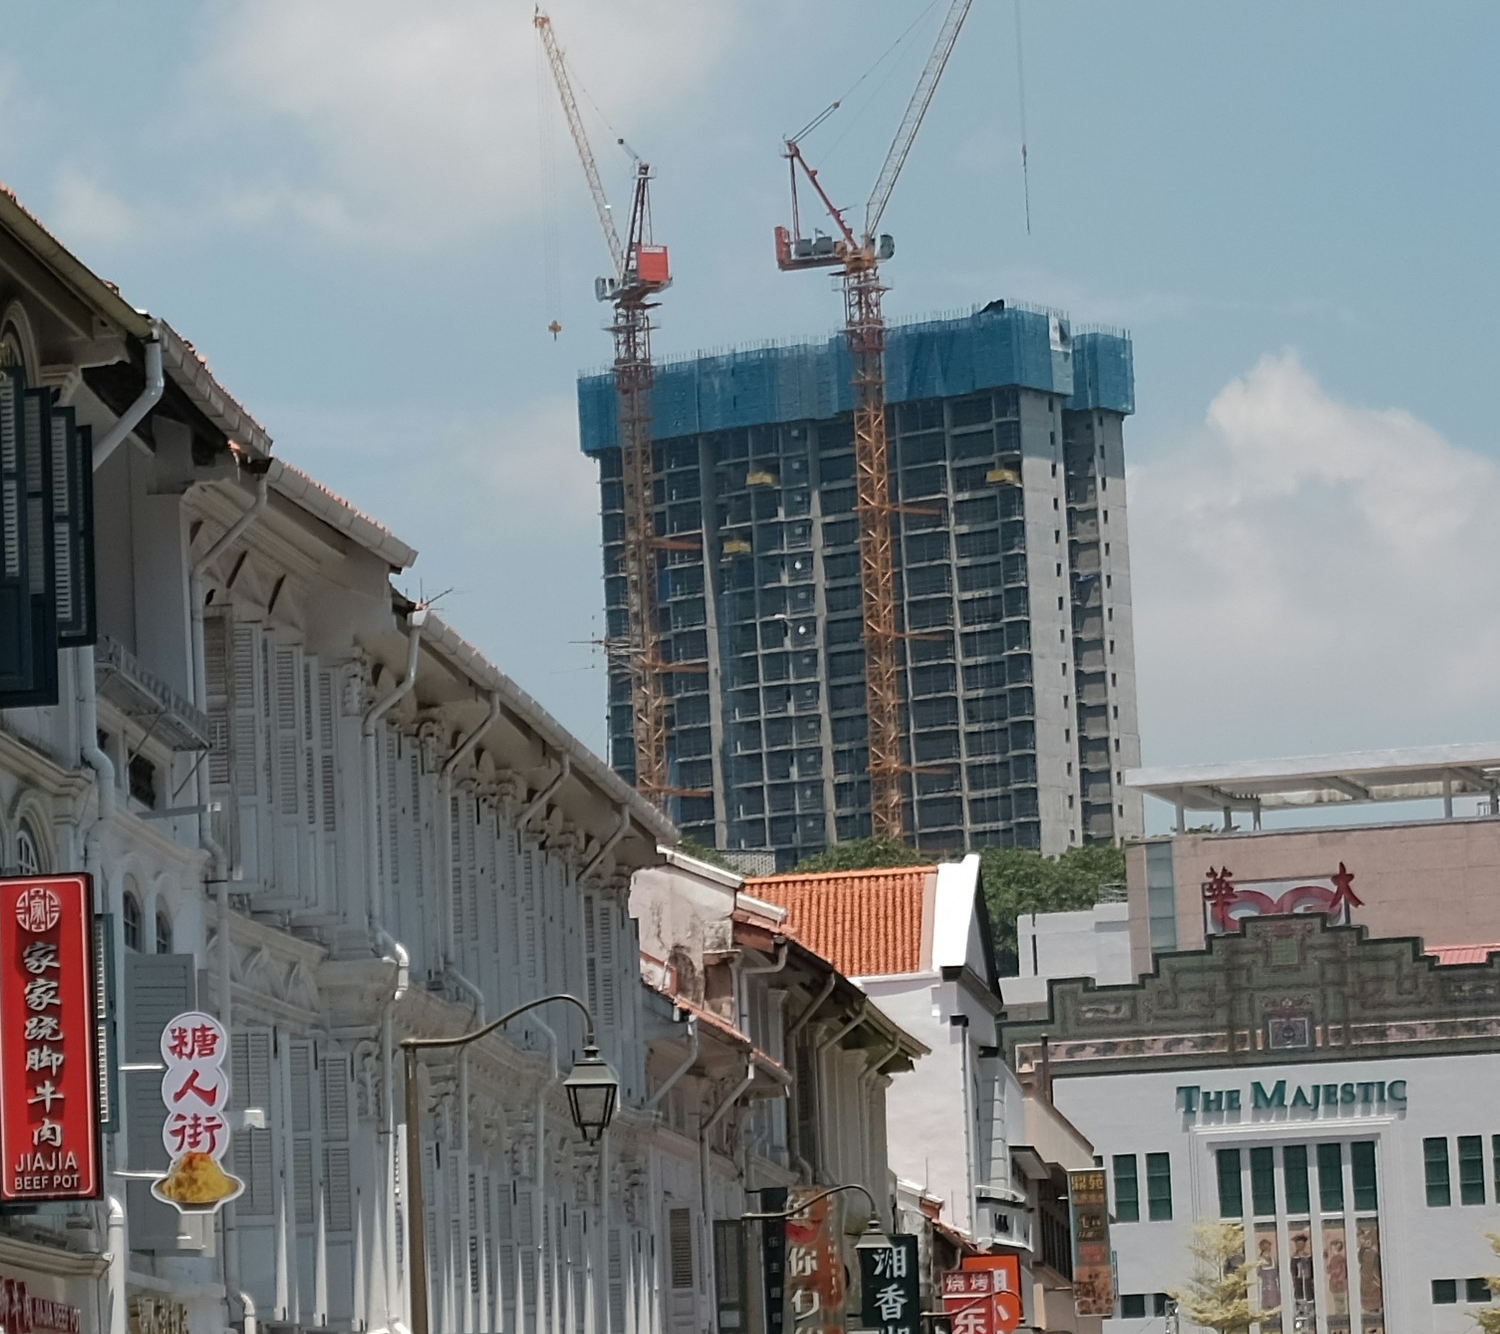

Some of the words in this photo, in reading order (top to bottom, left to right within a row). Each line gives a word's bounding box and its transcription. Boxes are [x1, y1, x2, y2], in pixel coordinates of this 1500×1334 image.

[167, 1023, 222, 1156] 糖人街
[15, 1151, 77, 1172] JIAJIA
[14, 1177, 50, 1191] BEEF
[53, 1174, 80, 1189] POT
